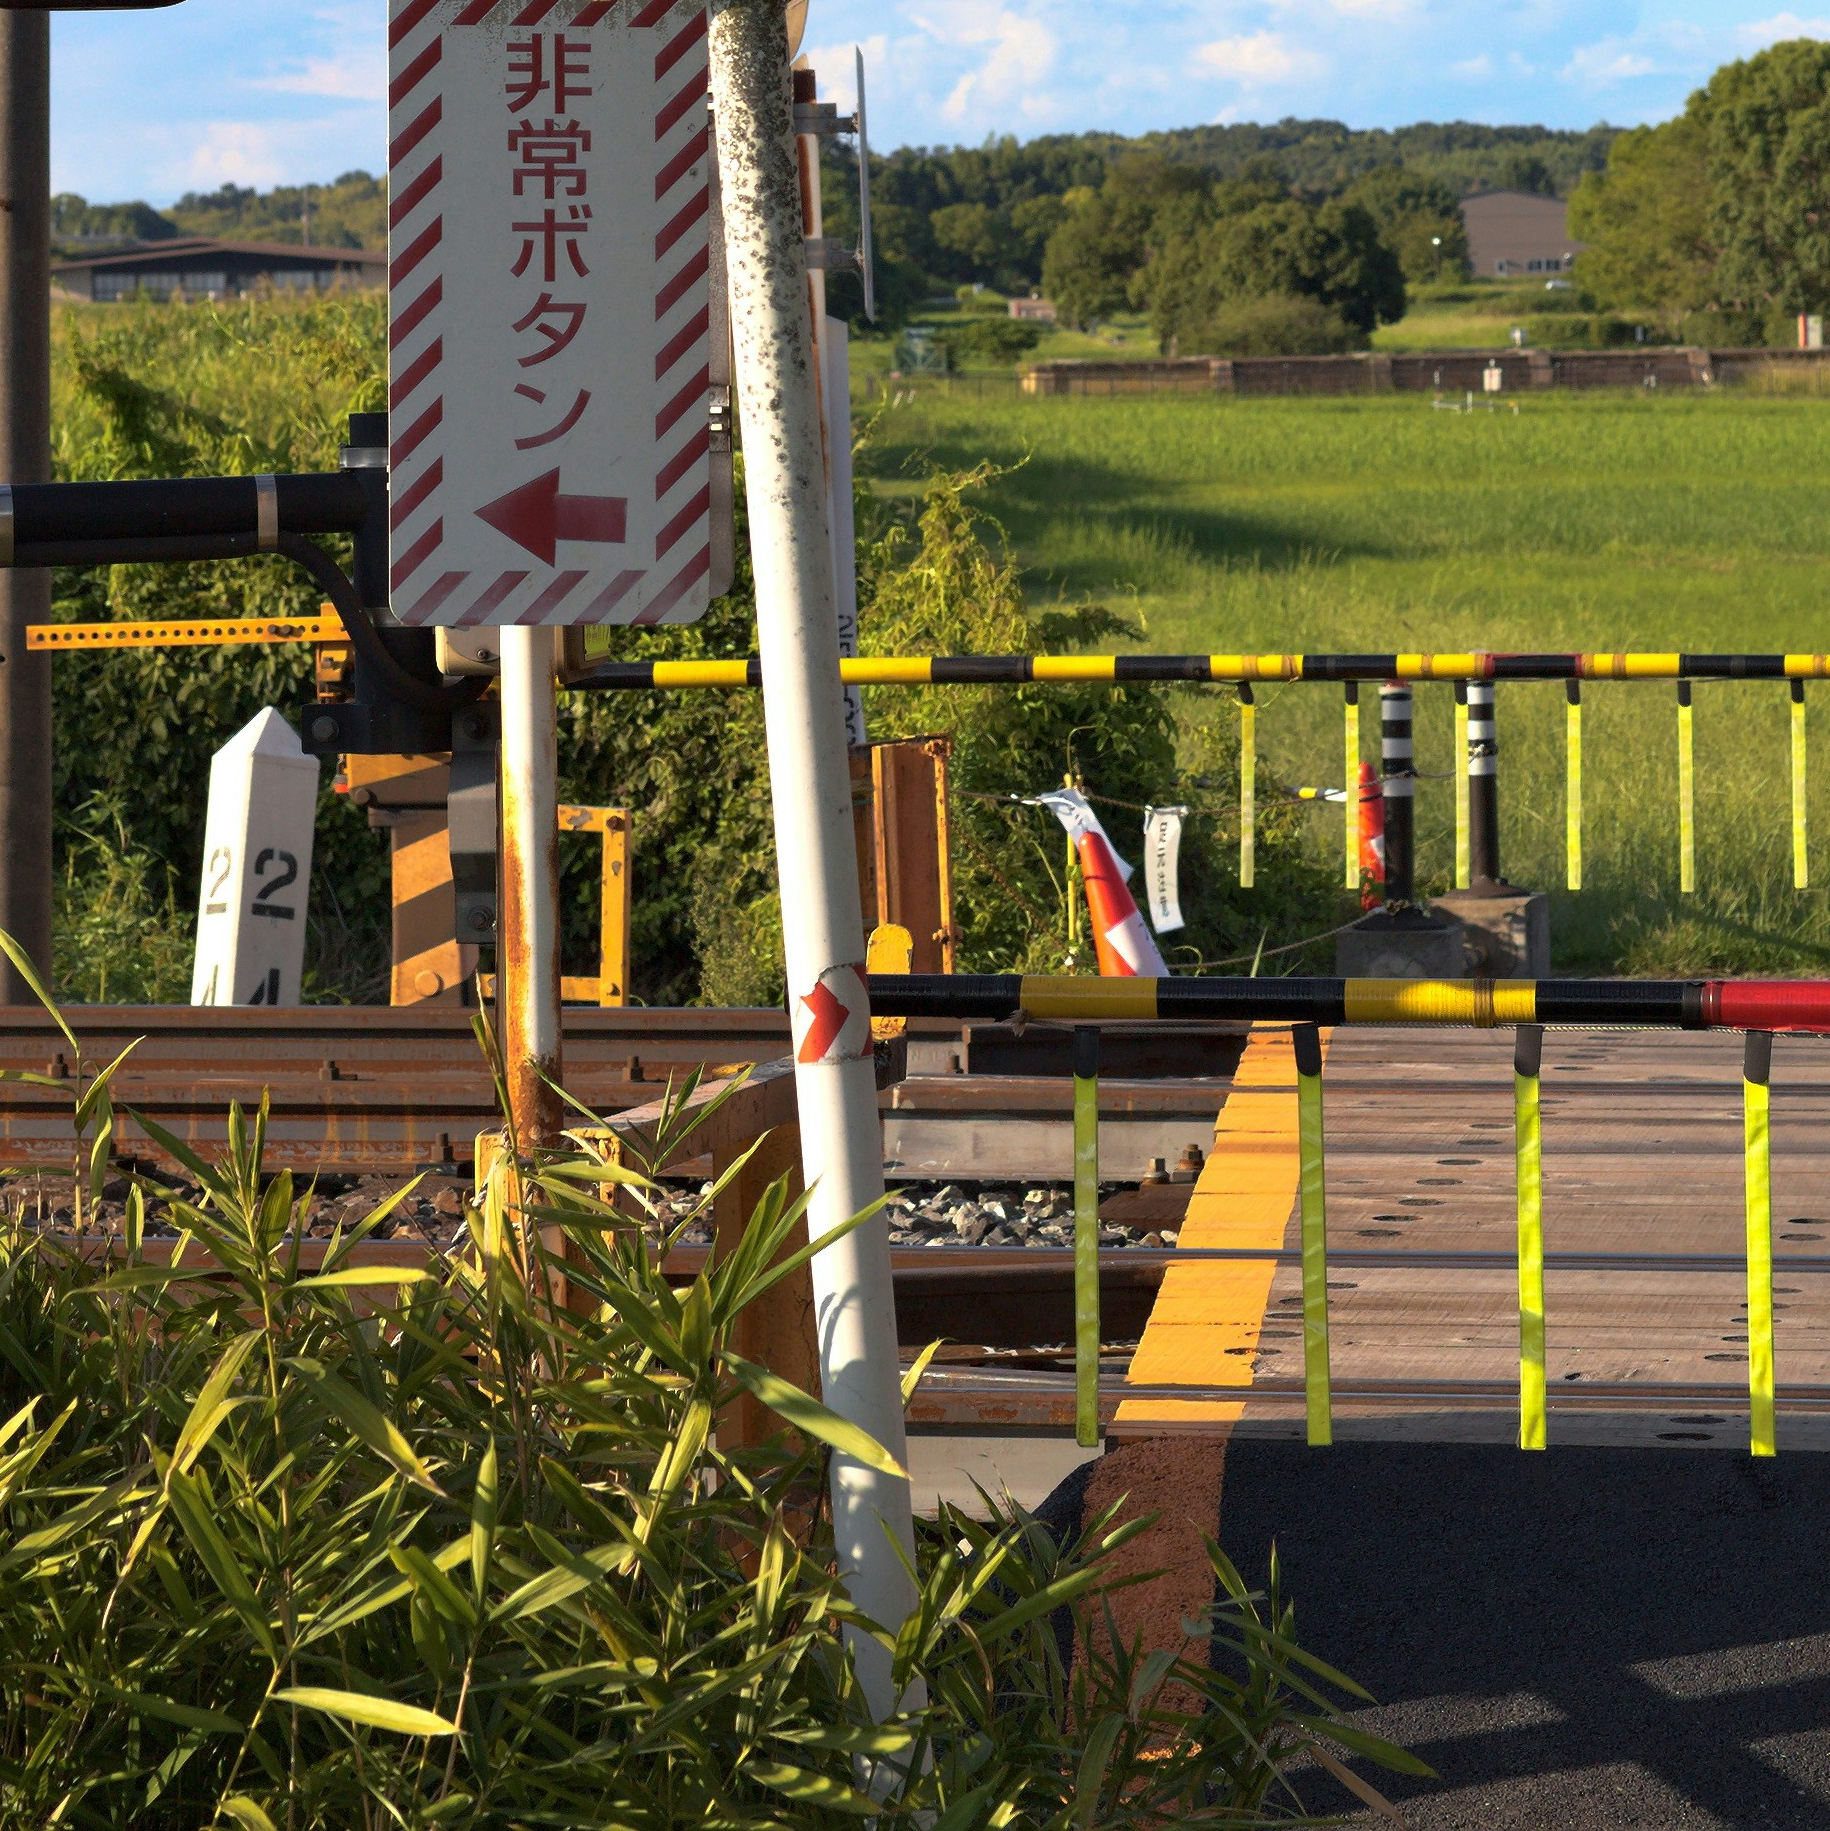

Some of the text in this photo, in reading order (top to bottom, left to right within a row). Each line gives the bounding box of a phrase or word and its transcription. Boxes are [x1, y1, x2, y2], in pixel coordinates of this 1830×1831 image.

[505, 33, 593, 451] 非常ボタン
[251, 847, 298, 921] 2
